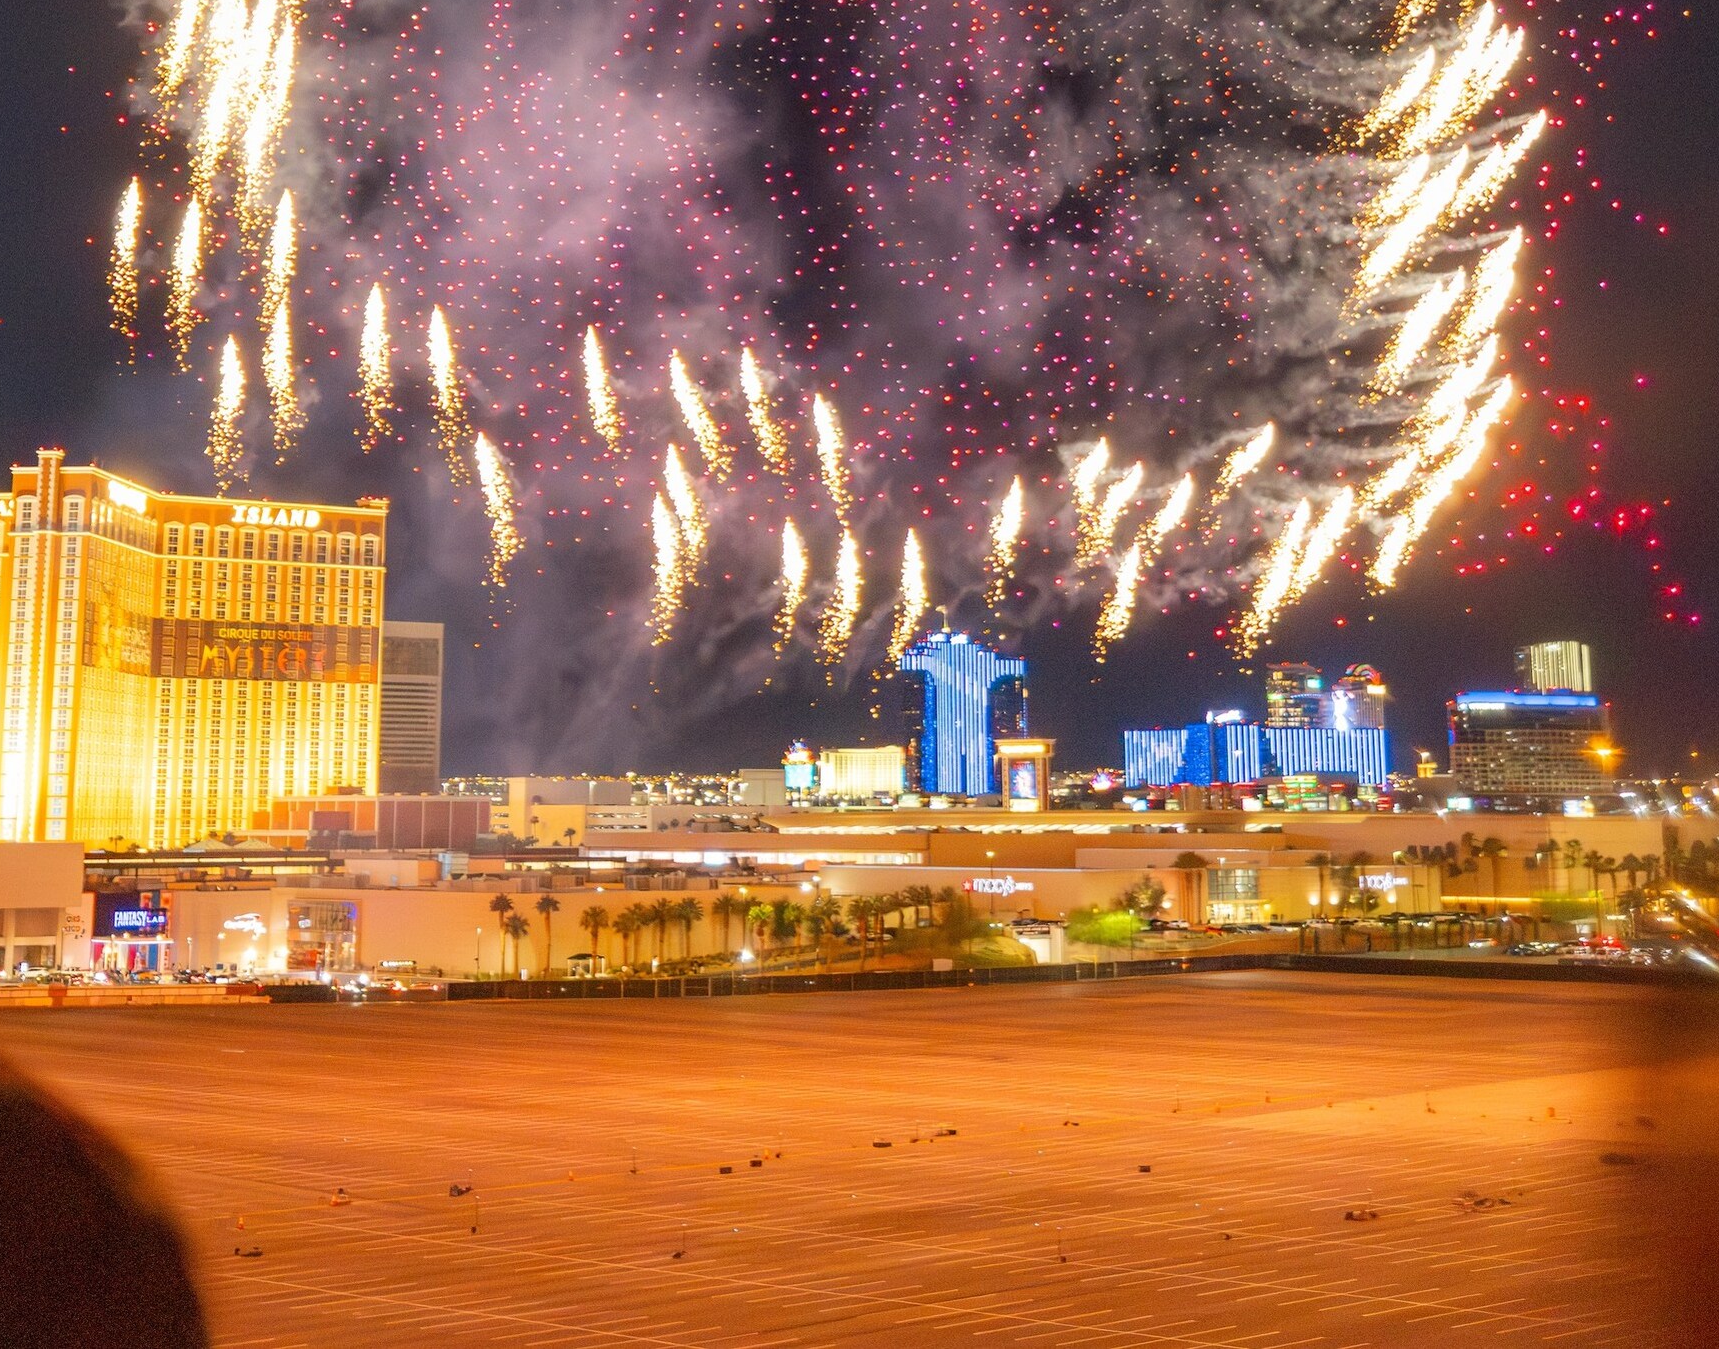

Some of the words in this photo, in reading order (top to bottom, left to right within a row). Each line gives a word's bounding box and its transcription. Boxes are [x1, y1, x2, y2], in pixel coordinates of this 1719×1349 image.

[231, 505, 321, 528] ISLAND
[219, 628, 258, 639] CIRQUE
[261, 629, 275, 640] DU
[278, 630, 313, 641] SOLEIL
[114, 910, 147, 928] FANTASY
